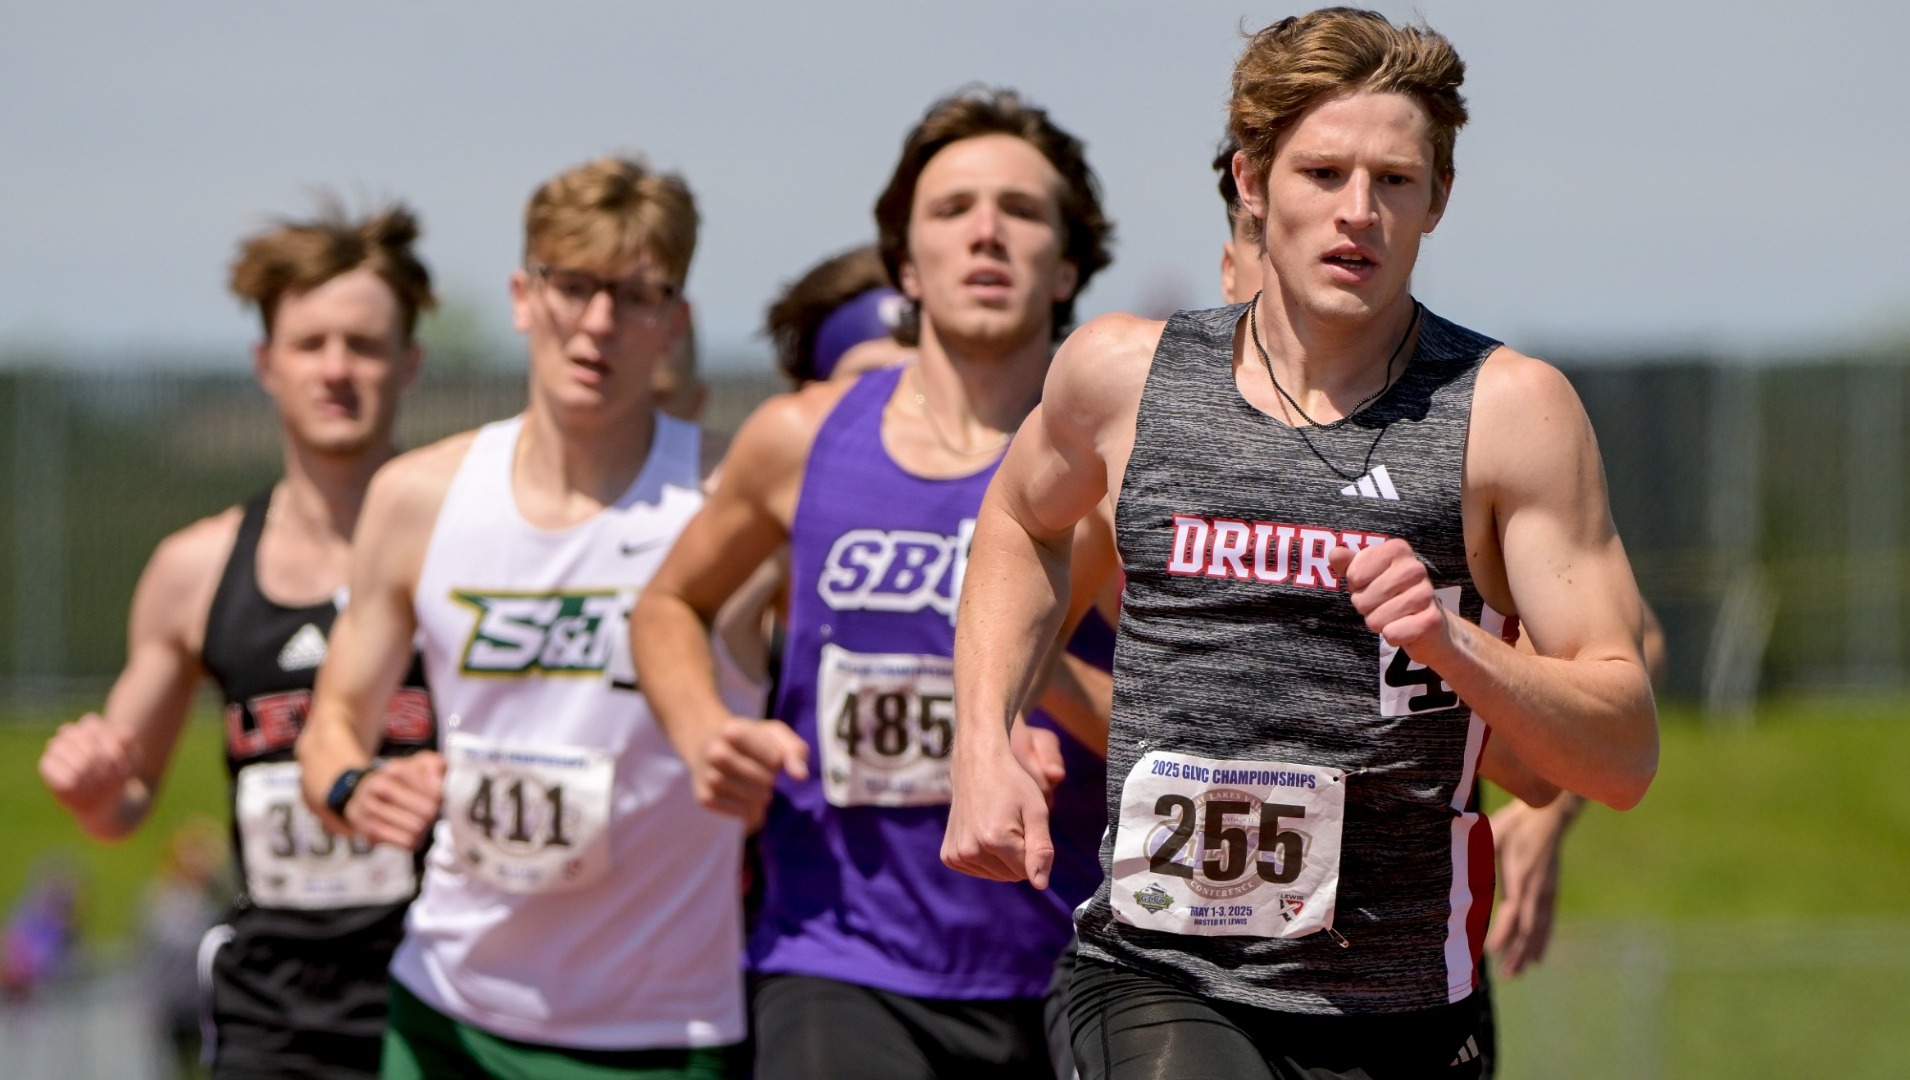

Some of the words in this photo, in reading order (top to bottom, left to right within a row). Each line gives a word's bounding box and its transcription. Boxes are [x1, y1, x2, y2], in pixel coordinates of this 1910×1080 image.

[836, 691, 956, 760] 485
[1151, 760, 1180, 778] 2025
[1182, 764, 1210, 784] GLVC
[1212, 768, 1317, 790] CHAMPIONSHIPS
[1209, 791, 1241, 800] LAKES
[468, 775, 572, 847] 411
[1149, 793, 1306, 884] 255
[1189, 880, 1255, 898] CONFERENCE
[1280, 893, 1304, 901] LEWIS
[1190, 906, 1209, 918] MAY
[1211, 906, 1227, 918] 1-3,
[1228, 906, 1253, 917] 2025
[1194, 918, 1219, 926] HOSTED
[1228, 918, 1248, 926] LEWIS
